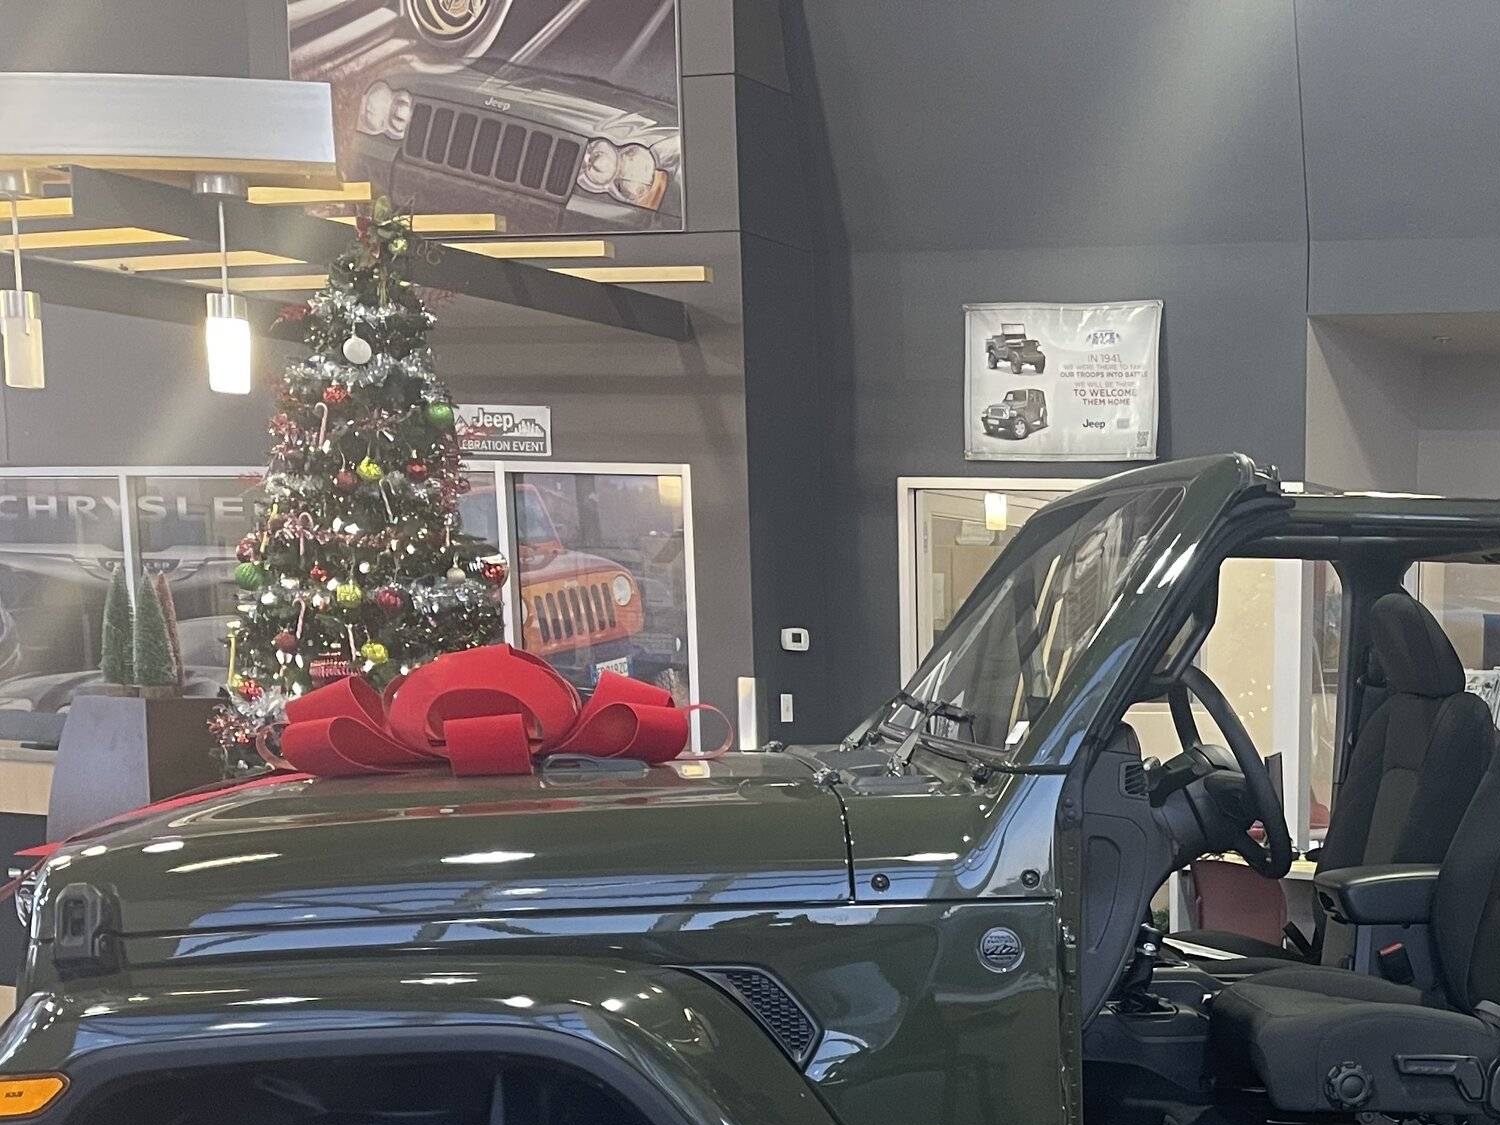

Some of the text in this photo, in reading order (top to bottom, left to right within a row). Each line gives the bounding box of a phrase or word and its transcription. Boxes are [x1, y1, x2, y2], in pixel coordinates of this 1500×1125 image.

[484, 97, 511, 112] Jeep
[1073, 388, 1137, 397] TO WELCOME
[1082, 398, 1131, 406] THEM HOME
[471, 407, 514, 432] Jeep
[1082, 418, 1106, 430] Jeep
[512, 441, 545, 452] EVENT
